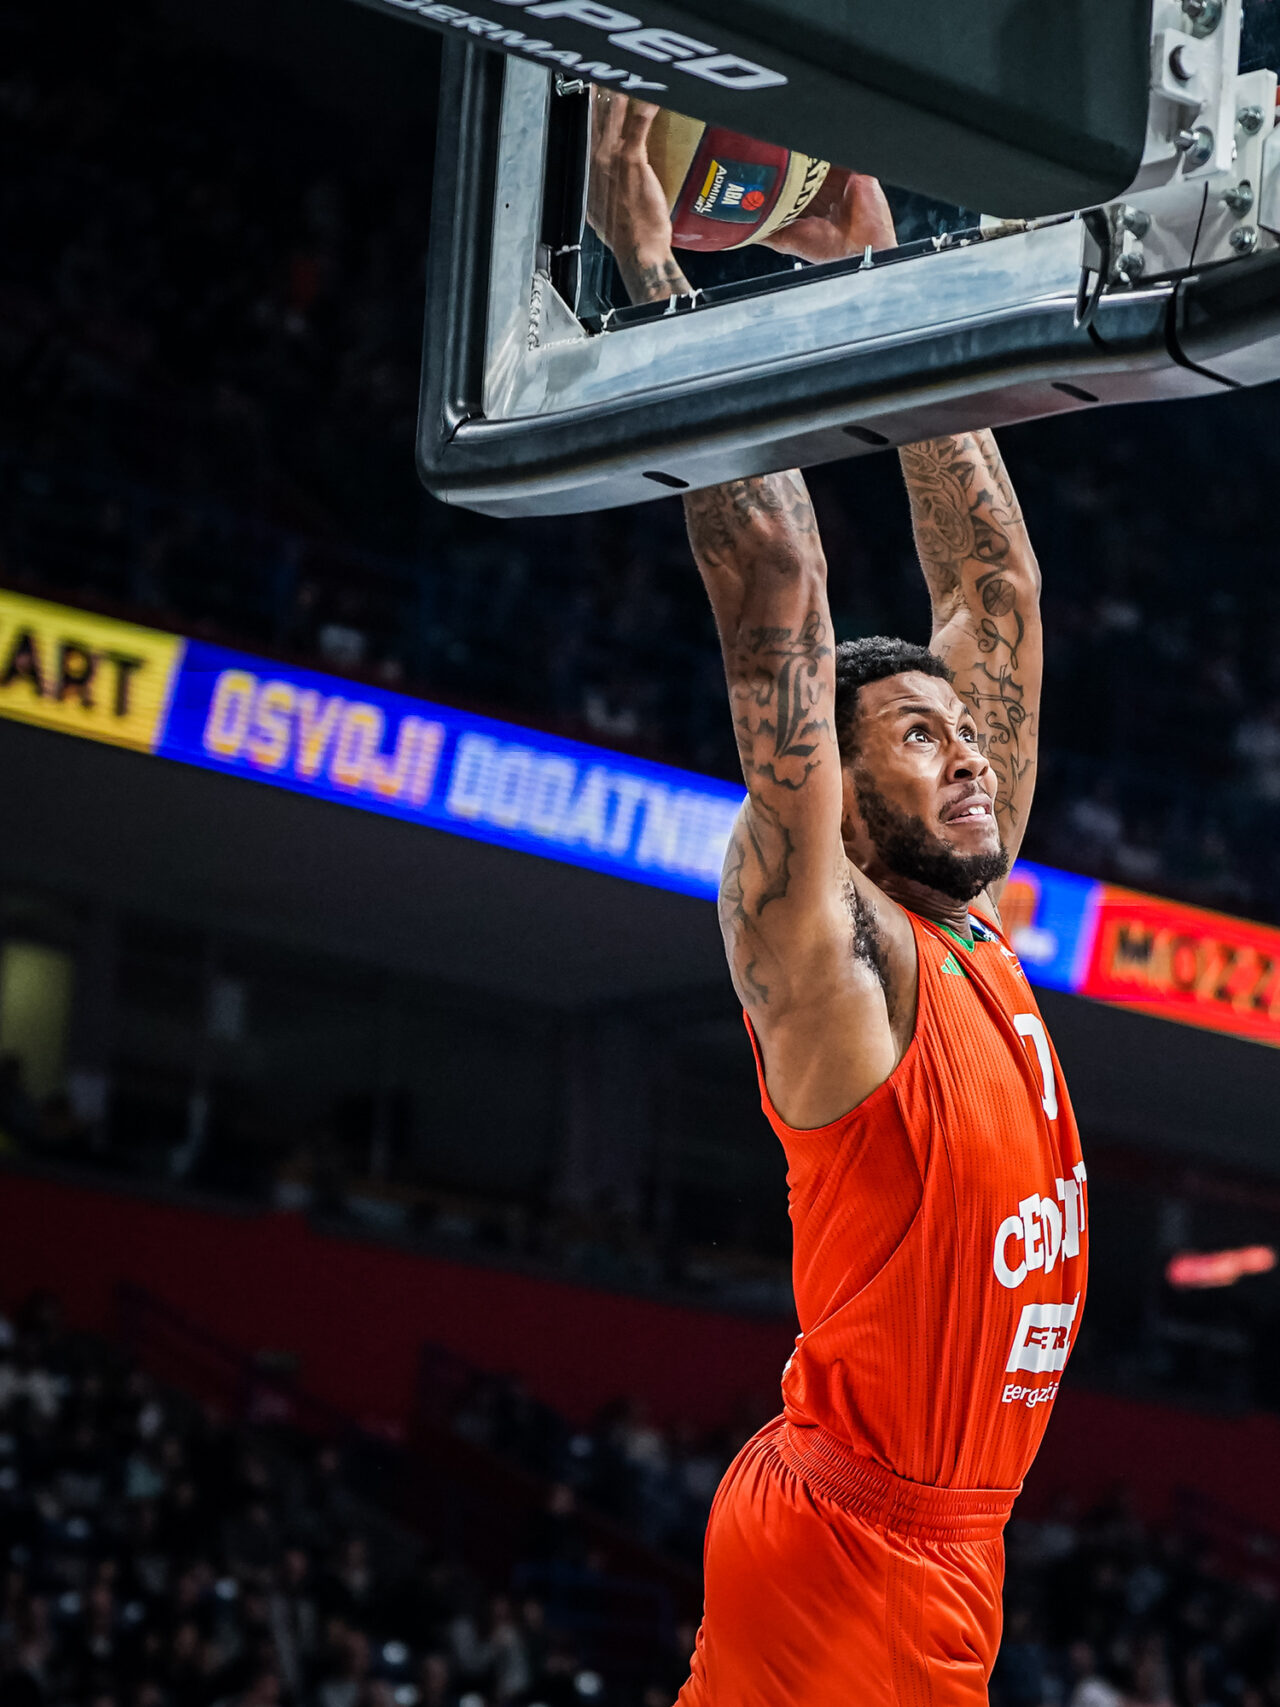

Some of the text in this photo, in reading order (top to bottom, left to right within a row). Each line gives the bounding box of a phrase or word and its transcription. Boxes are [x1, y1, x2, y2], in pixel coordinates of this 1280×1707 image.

[493, 0, 788, 90] PED
[700, 164, 728, 213] ADMIRAL
[721, 183, 745, 205] ABA
[203, 669, 445, 807] OSVOJI
